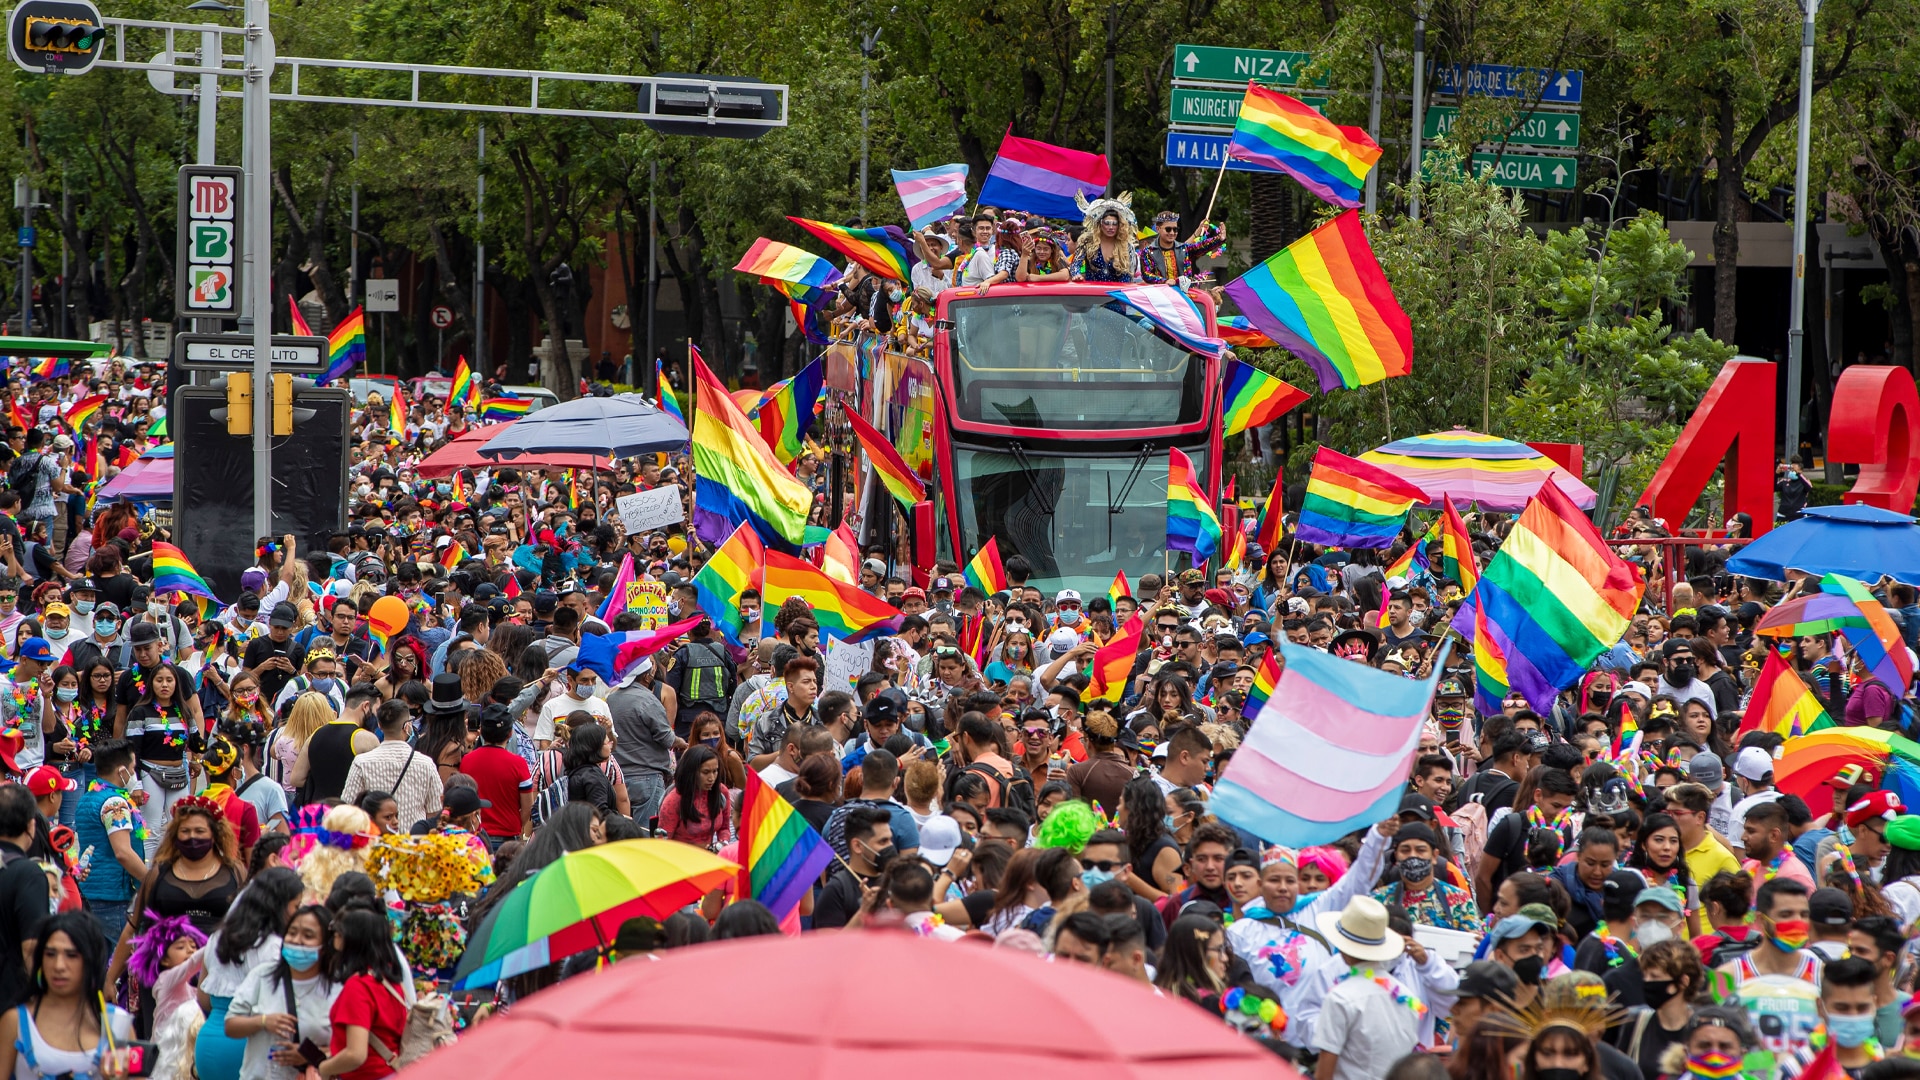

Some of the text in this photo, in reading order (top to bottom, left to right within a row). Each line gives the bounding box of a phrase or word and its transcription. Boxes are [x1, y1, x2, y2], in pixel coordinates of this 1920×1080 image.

[1233, 55, 1291, 77] NIZA
[1437, 67, 1482, 89] SENDO
[1488, 71, 1502, 90] DE
[1182, 96, 1243, 118] INSURGENT
[1177, 140, 1186, 158] M
[1190, 142, 1199, 160] A
[1204, 142, 1219, 161] LA
[196, 181, 228, 213] MB
[209, 348, 298, 361] EL CABLITO
[628, 582, 667, 604] JICALETAS
